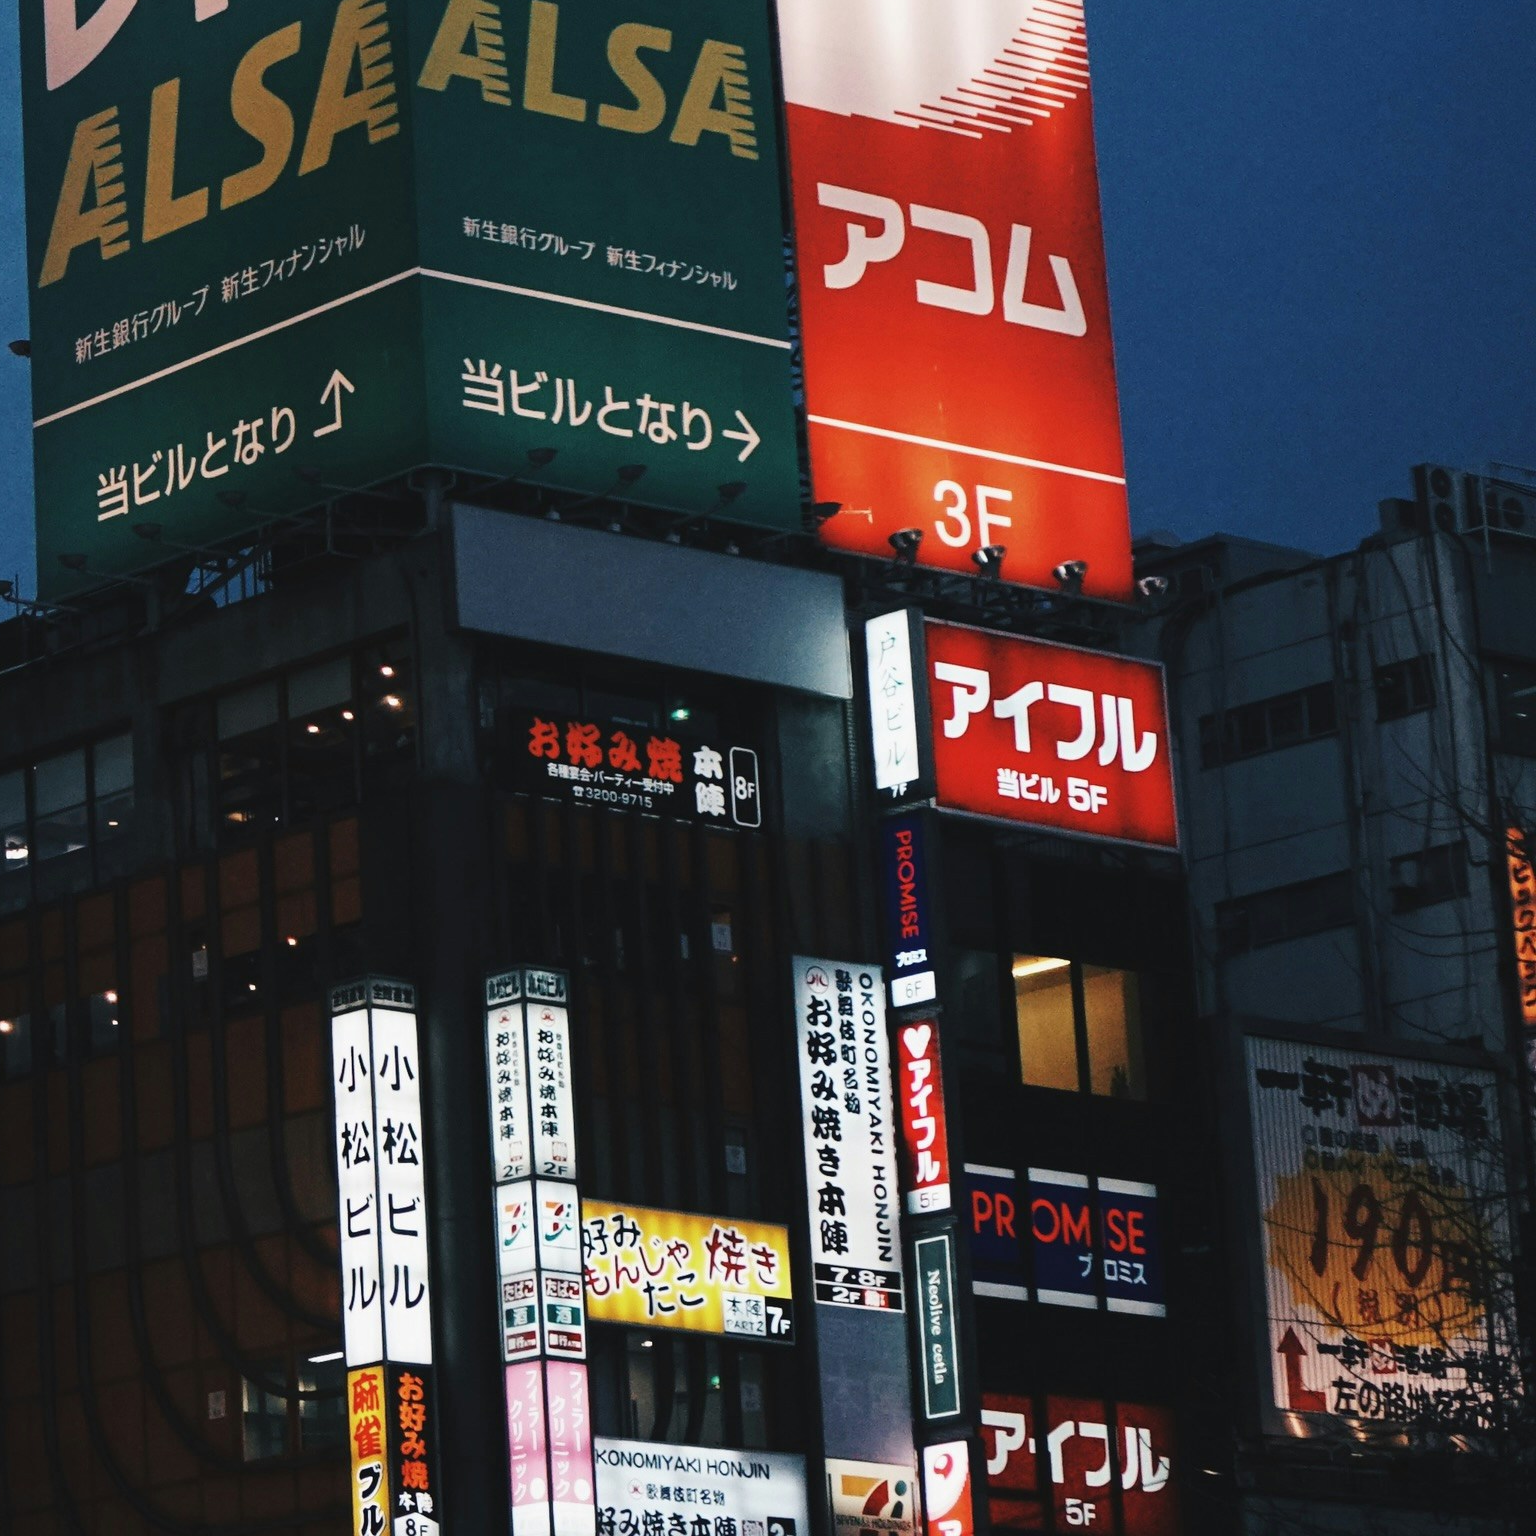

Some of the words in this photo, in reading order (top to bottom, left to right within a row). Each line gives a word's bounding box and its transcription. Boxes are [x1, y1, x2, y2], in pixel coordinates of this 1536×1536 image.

[463, 216, 595, 262] 新生銀行グループ
[606, 245, 738, 292] 新生フィナンシャル
[817, 182, 1087, 337] アコム
[75, 286, 209, 365] 新生銀行グループ
[221, 223, 366, 304] 新生フィナンシャル
[460, 357, 715, 451] 当ビルとなり
[96, 406, 297, 523] 当ビルとなり
[933, 480, 1013, 549] 3F
[934, 661, 1158, 773] アイフル
[528, 717, 684, 784] お好み焼
[693, 745, 726, 817] 本陣
[586, 786, 653, 808] 3200-9715
[735, 776, 755, 800] 8F
[890, 784, 908, 798] 7F
[996, 768, 1060, 805] 当ビル
[1068, 778, 1108, 814] 5F
[896, 830, 918, 939] PROMISE
[905, 981, 922, 999] 6F
[806, 996, 848, 1255] お好み焼き本陣
[859, 972, 883, 1156] OKONOMIYAKI
[873, 1167, 892, 1261] HONJIN
[907, 1059, 940, 1183] アイフル
[339, 1046, 377, 1313] 小松ビル
[380, 1045, 425, 1309] 小松ビル
[503, 1165, 523, 1178] 2F
[544, 1162, 568, 1175] 2F
[920, 1192, 940, 1207] 5F
[973, 1191, 1146, 1254] PROMSE
[584, 1240, 688, 1295] もんじゃ
[705, 1229, 775, 1284] 焼き
[643, 1273, 703, 1316] たこ
[726, 1298, 761, 1317] 本陣
[767, 1306, 791, 1334] 7F
[832, 1287, 860, 1303] 2F
[928, 1270, 940, 1336] Neolive
[398, 1372, 429, 1490] お好み焼
[981, 1409, 1170, 1492] アイフル
[707, 1460, 770, 1480] HONJIN
[1065, 1497, 1096, 1526] 5F
